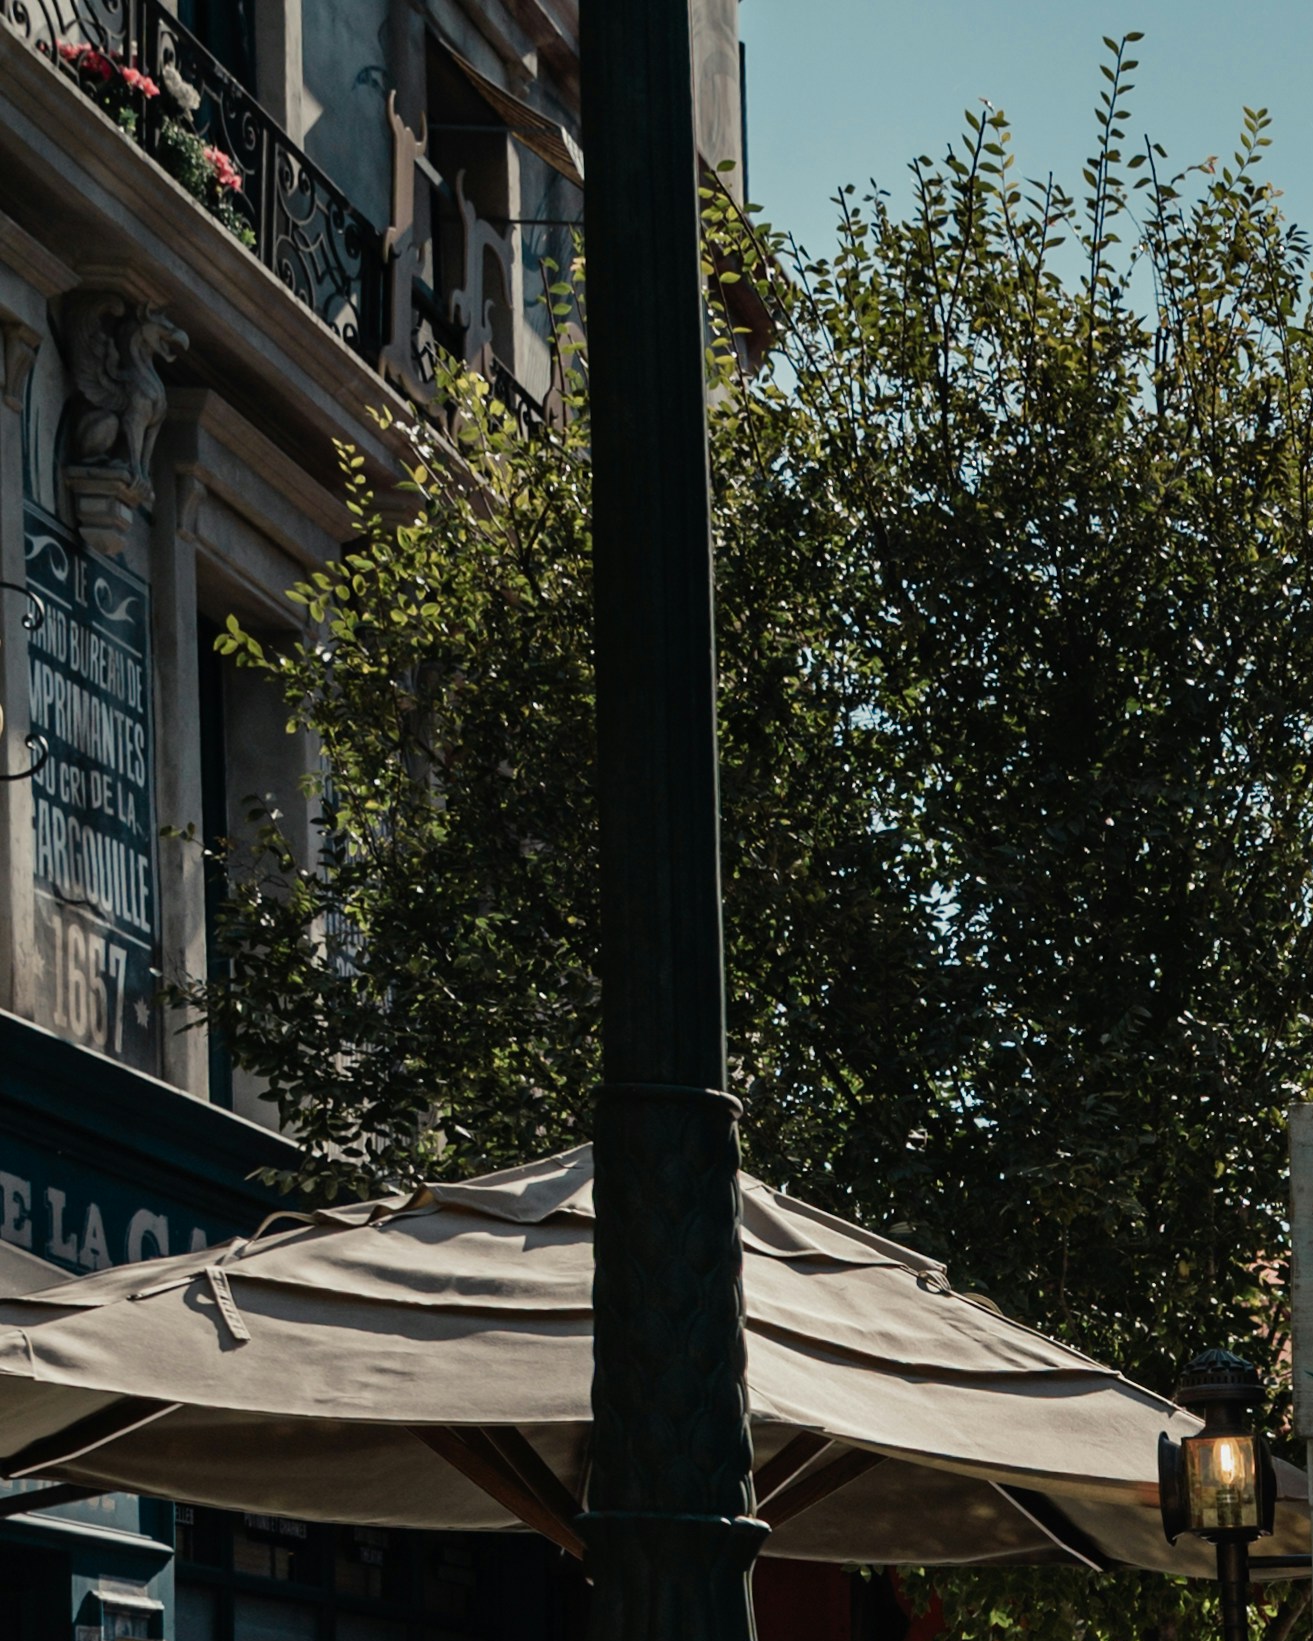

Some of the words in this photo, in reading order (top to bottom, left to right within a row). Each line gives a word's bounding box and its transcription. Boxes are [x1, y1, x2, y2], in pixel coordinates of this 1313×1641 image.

[74, 555, 88, 607] LE
[70, 619, 125, 700] BUREAU
[127, 658, 144, 714] DE
[60, 762, 87, 808] CRI
[91, 770, 115, 816] DE
[117, 781, 138, 836] LA
[33, 798, 152, 934] ARGOUILLE
[53, 914, 128, 1054] 1657
[45, 1186, 113, 1270] LA
